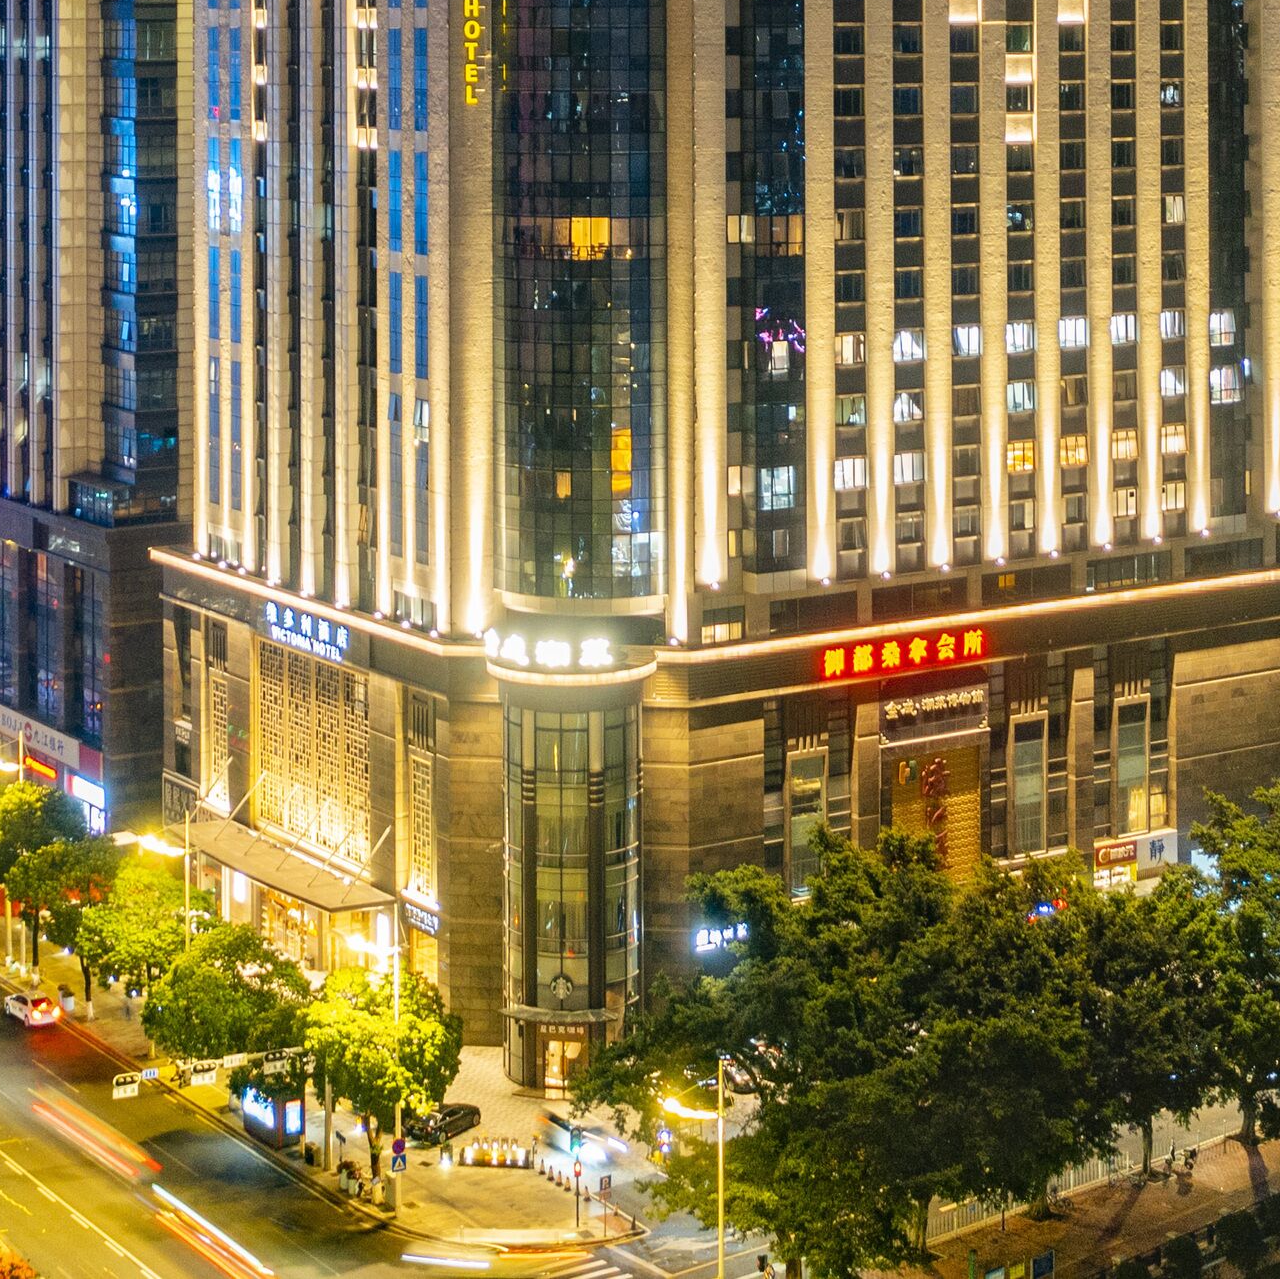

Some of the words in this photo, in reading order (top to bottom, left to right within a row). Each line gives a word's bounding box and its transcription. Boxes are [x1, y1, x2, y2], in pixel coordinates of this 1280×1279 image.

[266, 601, 349, 649] 维多利酒店
[271, 624, 313, 652] VICTORIA
[312, 638, 343, 662] HOTEL
[540, 1024, 585, 1035] 星巴克咖啡
